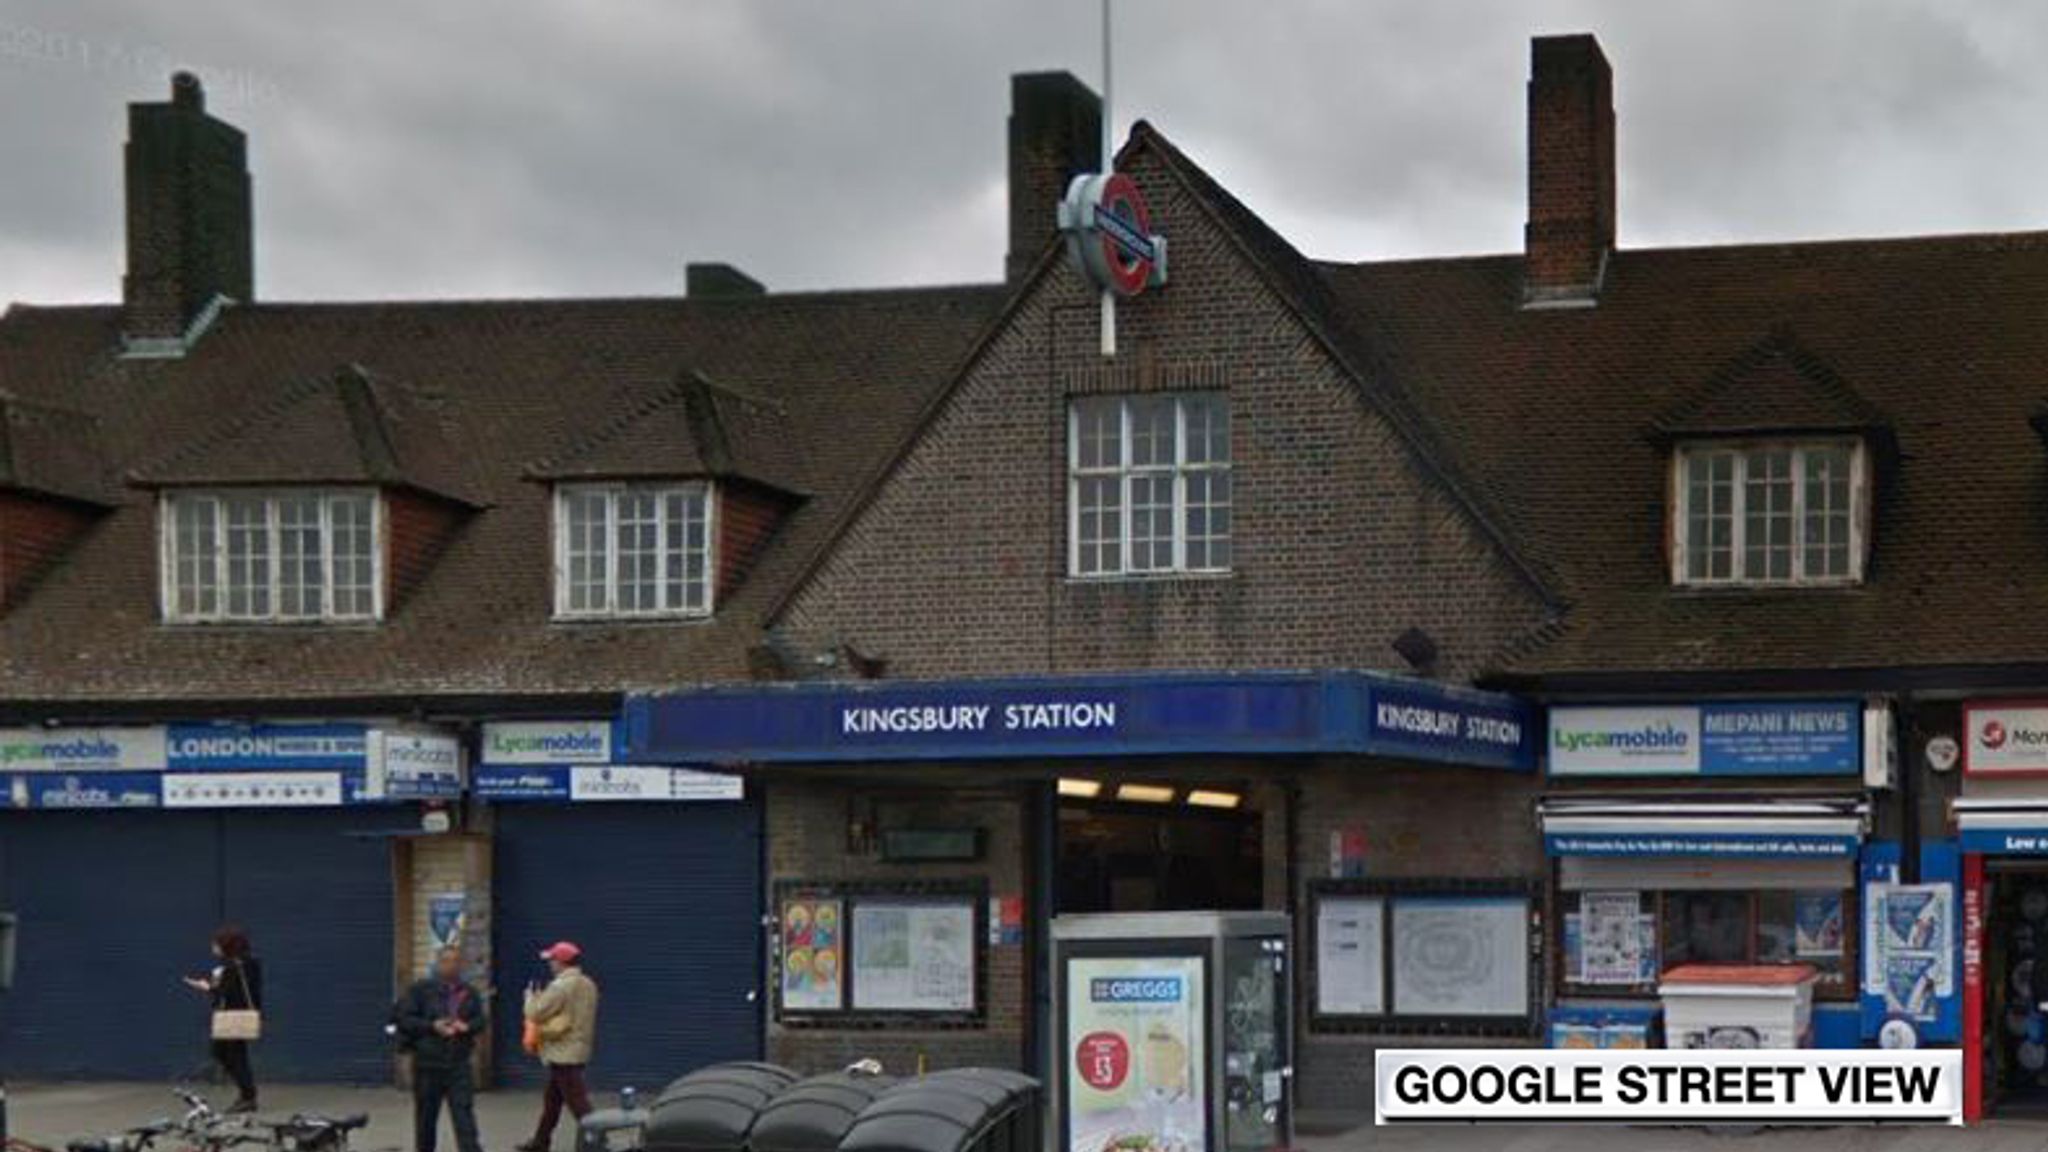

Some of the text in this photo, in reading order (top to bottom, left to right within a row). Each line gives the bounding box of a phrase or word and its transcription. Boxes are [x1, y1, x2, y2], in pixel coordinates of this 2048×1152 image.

[843, 703, 1115, 732] KINGSBURY STATION
[1377, 703, 1521, 747] KINGSBURY STATION
[1705, 711, 1848, 733] MEPANI NEWS
[168, 737, 273, 758] LONDON
[1555, 724, 1688, 752] Lycamobile
[1110, 980, 1179, 999] GREGGS
